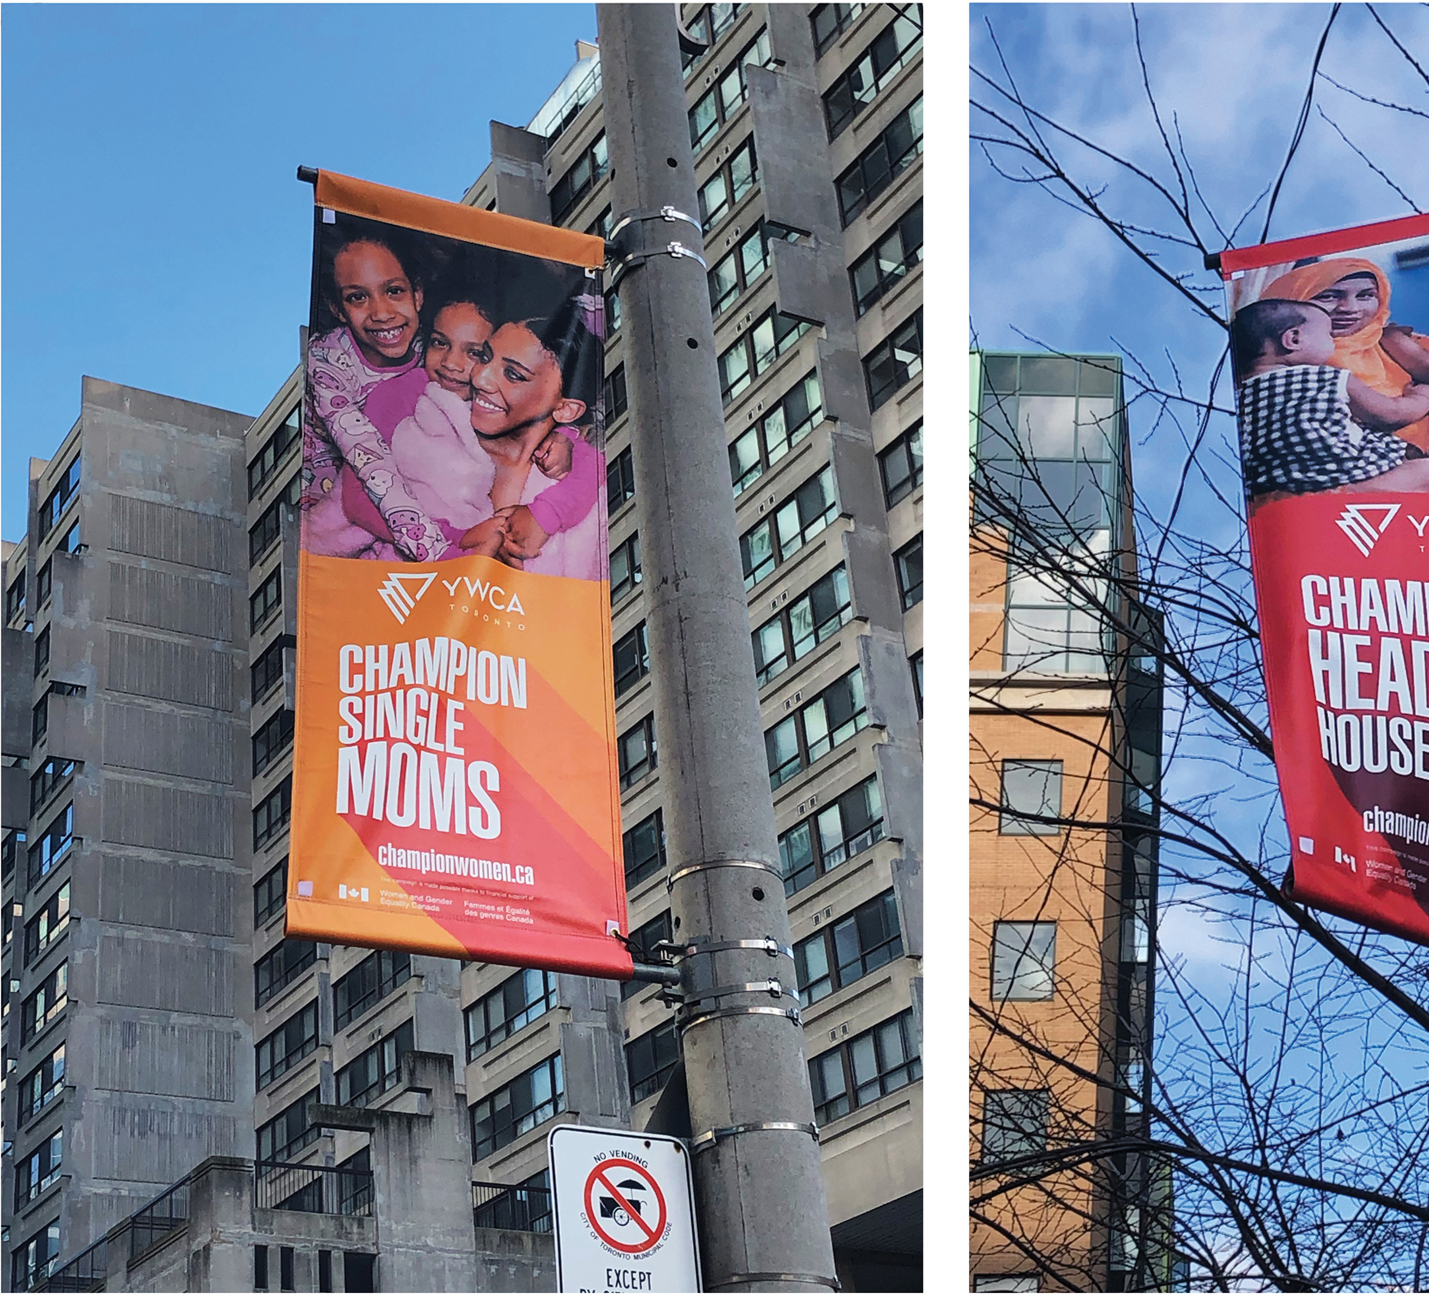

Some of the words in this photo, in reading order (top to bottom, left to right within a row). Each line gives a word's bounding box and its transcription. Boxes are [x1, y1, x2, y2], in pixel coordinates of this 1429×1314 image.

[442, 577, 525, 616] YWCA
[450, 604, 525, 630] TORONTO
[340, 636, 527, 708] CHAMPION
[339, 688, 464, 755] SINGLE
[336, 741, 500, 840] MOMS
[378, 843, 534, 885] championwomen.ca
[380, 890, 408, 900] Women
[409, 893, 424, 901] and
[425, 894, 453, 905] Gender
[380, 898, 410, 909] Equality
[411, 901, 440, 912] Canada
[464, 900, 495, 912] Femmes
[505, 903, 530, 916] Égalité
[464, 909, 478, 917] des
[480, 912, 504, 921] genres
[505, 913, 534, 924] Canada
[593, 1152, 607, 1163] NO
[609, 1150, 649, 1169] VENDING
[580, 1212, 591, 1229] CITY
[590, 1231, 598, 1241] OF
[600, 1242, 631, 1260] TORONTO
[634, 1242, 664, 1261] MUNICIPAL
[662, 1222, 673, 1241] CODE
[606, 1269, 652, 1291] EXCEPT
